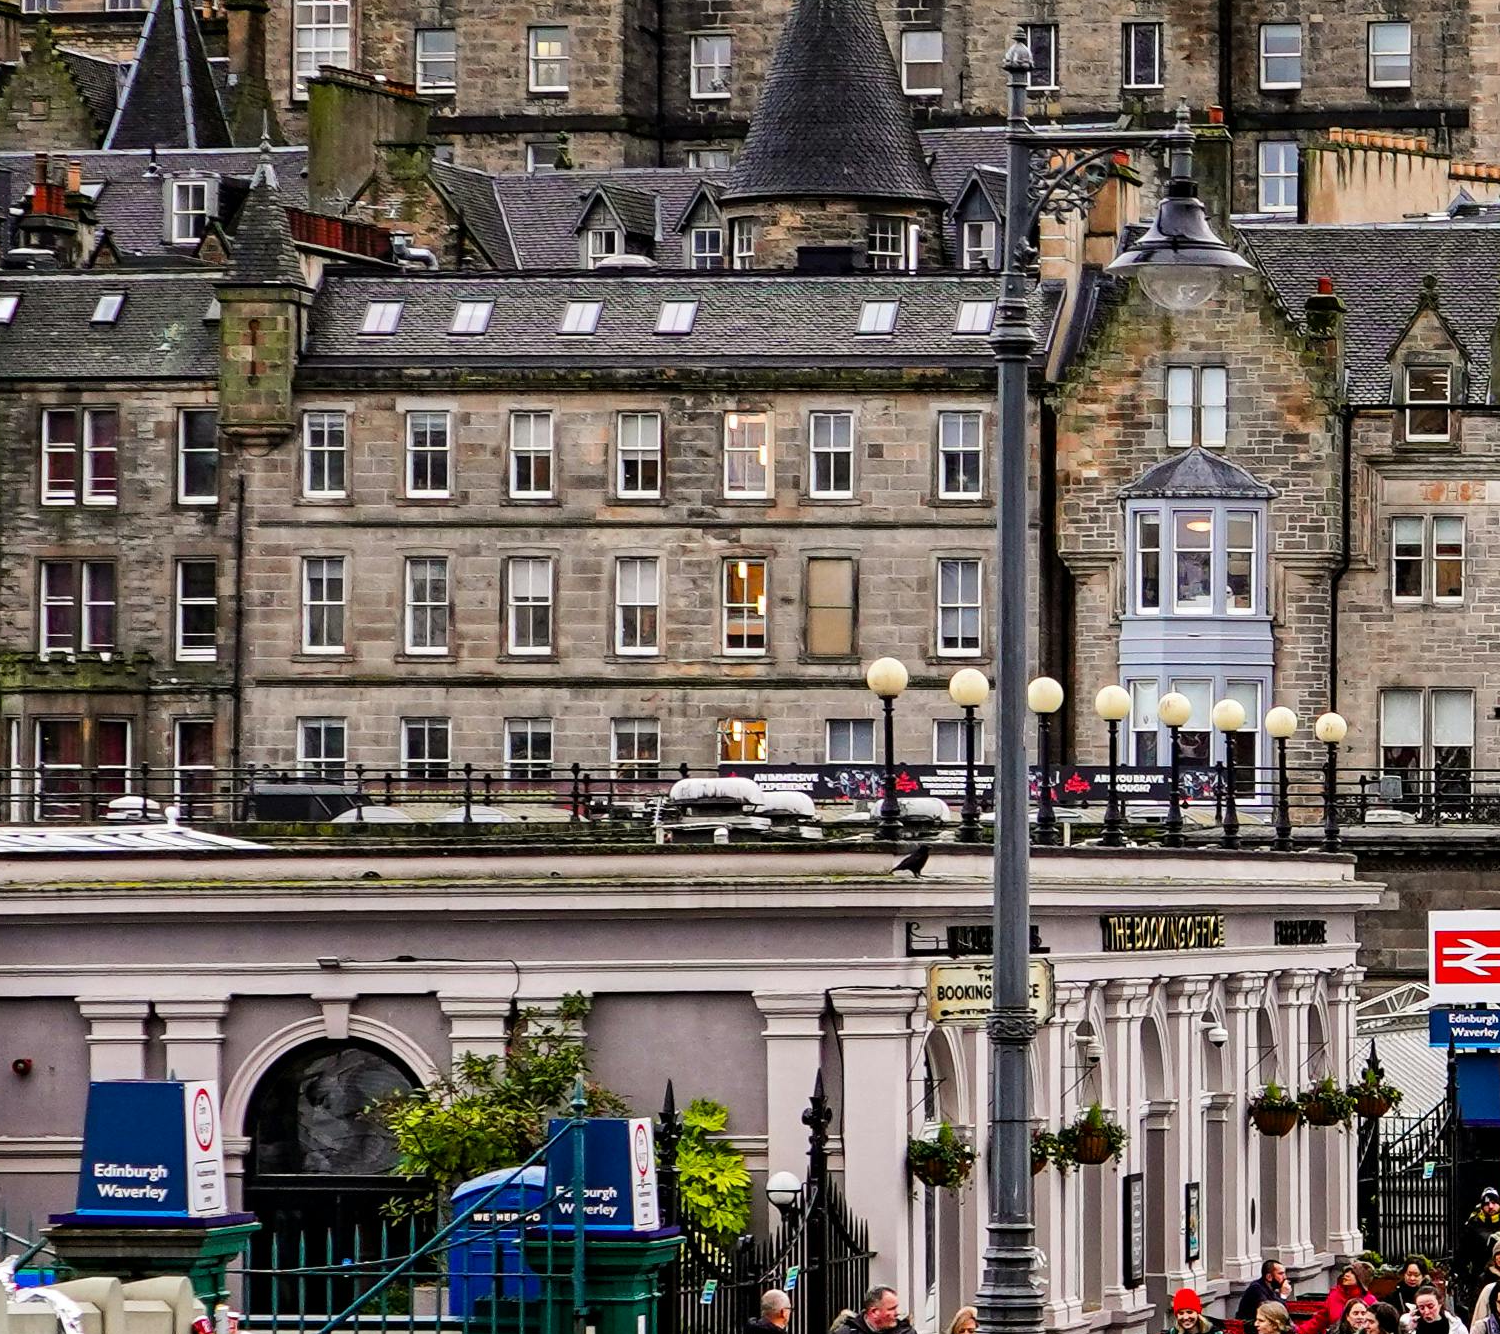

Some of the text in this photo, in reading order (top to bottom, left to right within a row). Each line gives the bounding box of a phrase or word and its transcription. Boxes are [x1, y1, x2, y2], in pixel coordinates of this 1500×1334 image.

[1419, 482, 1486, 501] THE
[1109, 915, 1225, 951] THE BOOKING OFFICE
[978, 973, 992, 982] TH
[937, 985, 993, 1001] BOOKING
[1449, 1013, 1499, 1026] Edinburgh
[1451, 1027, 1500, 1039] Waverley
[93, 1163, 169, 1182] Edinburgh
[97, 1183, 169, 1202] Waverley
